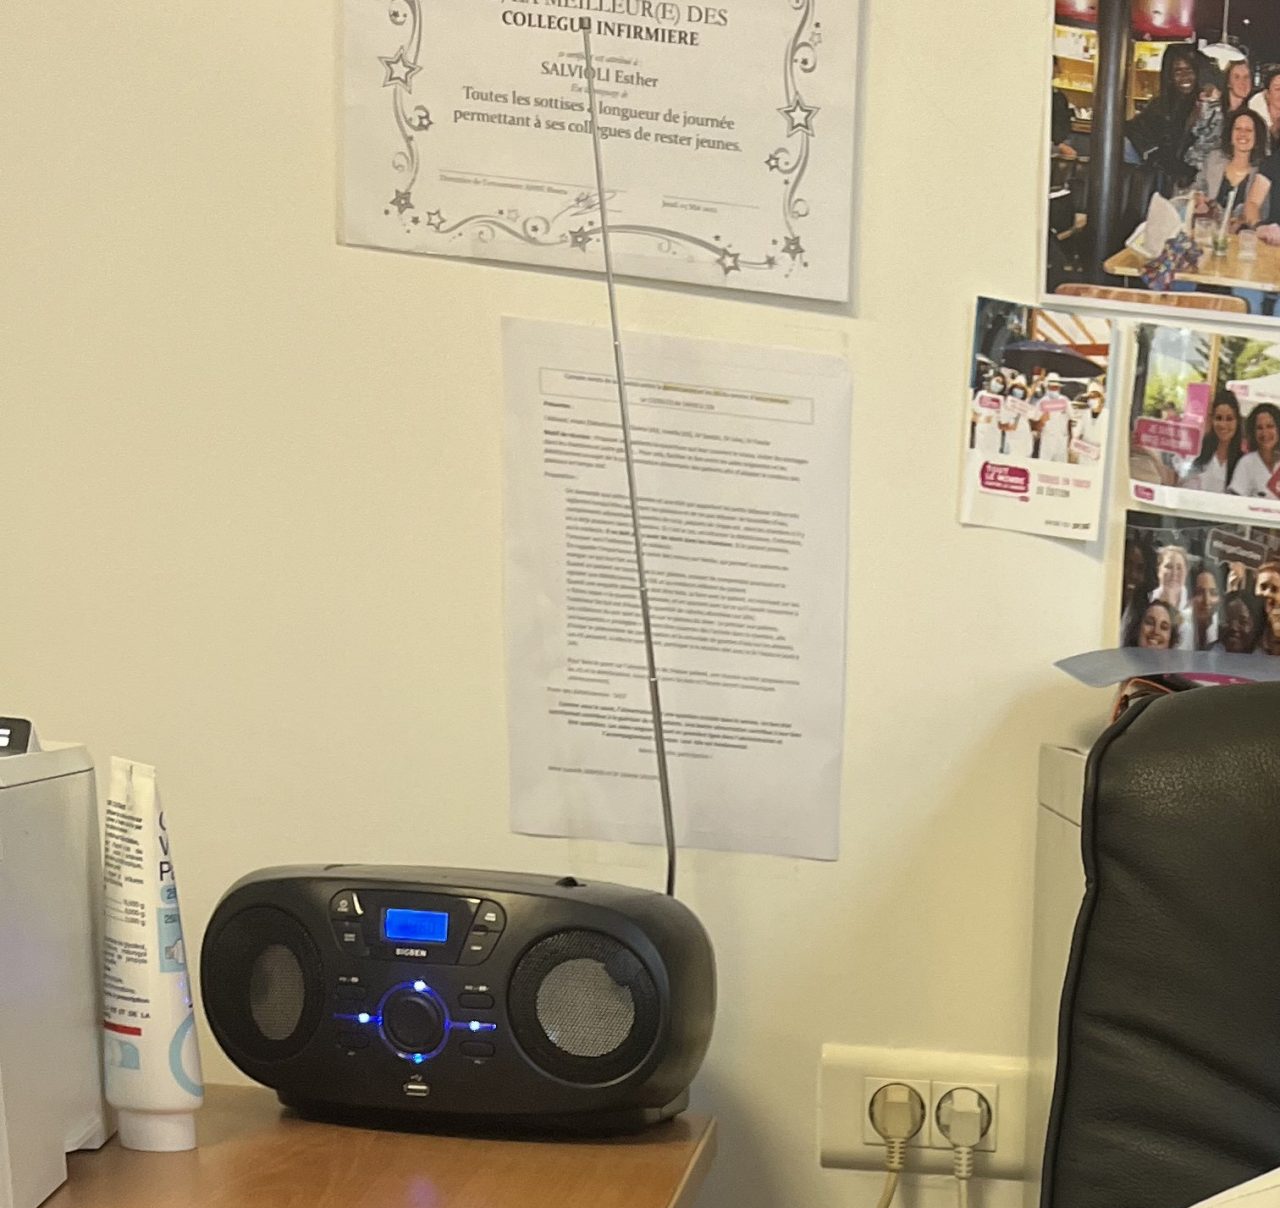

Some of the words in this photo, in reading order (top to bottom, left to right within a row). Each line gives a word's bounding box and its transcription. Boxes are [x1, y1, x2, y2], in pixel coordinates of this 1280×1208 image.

[502, 10, 590, 33] COLLEGU
[597, 20, 700, 47] INFIRMIERE
[687, 5, 728, 27] DES
[615, 70, 659, 88] Esther
[462, 85, 508, 104] Toutes
[512, 90, 531, 106] les
[533, 94, 585, 112] sottises
[599, 101, 660, 122] longueur
[663, 106, 681, 123] de
[682, 110, 736, 130] journée
[453, 108, 531, 129] permettant
[533, 114, 542, 129] à
[545, 118, 565, 131] ses
[567, 120, 632, 140] collgues
[634, 127, 652, 142] de
[654, 132, 693, 147] rester
